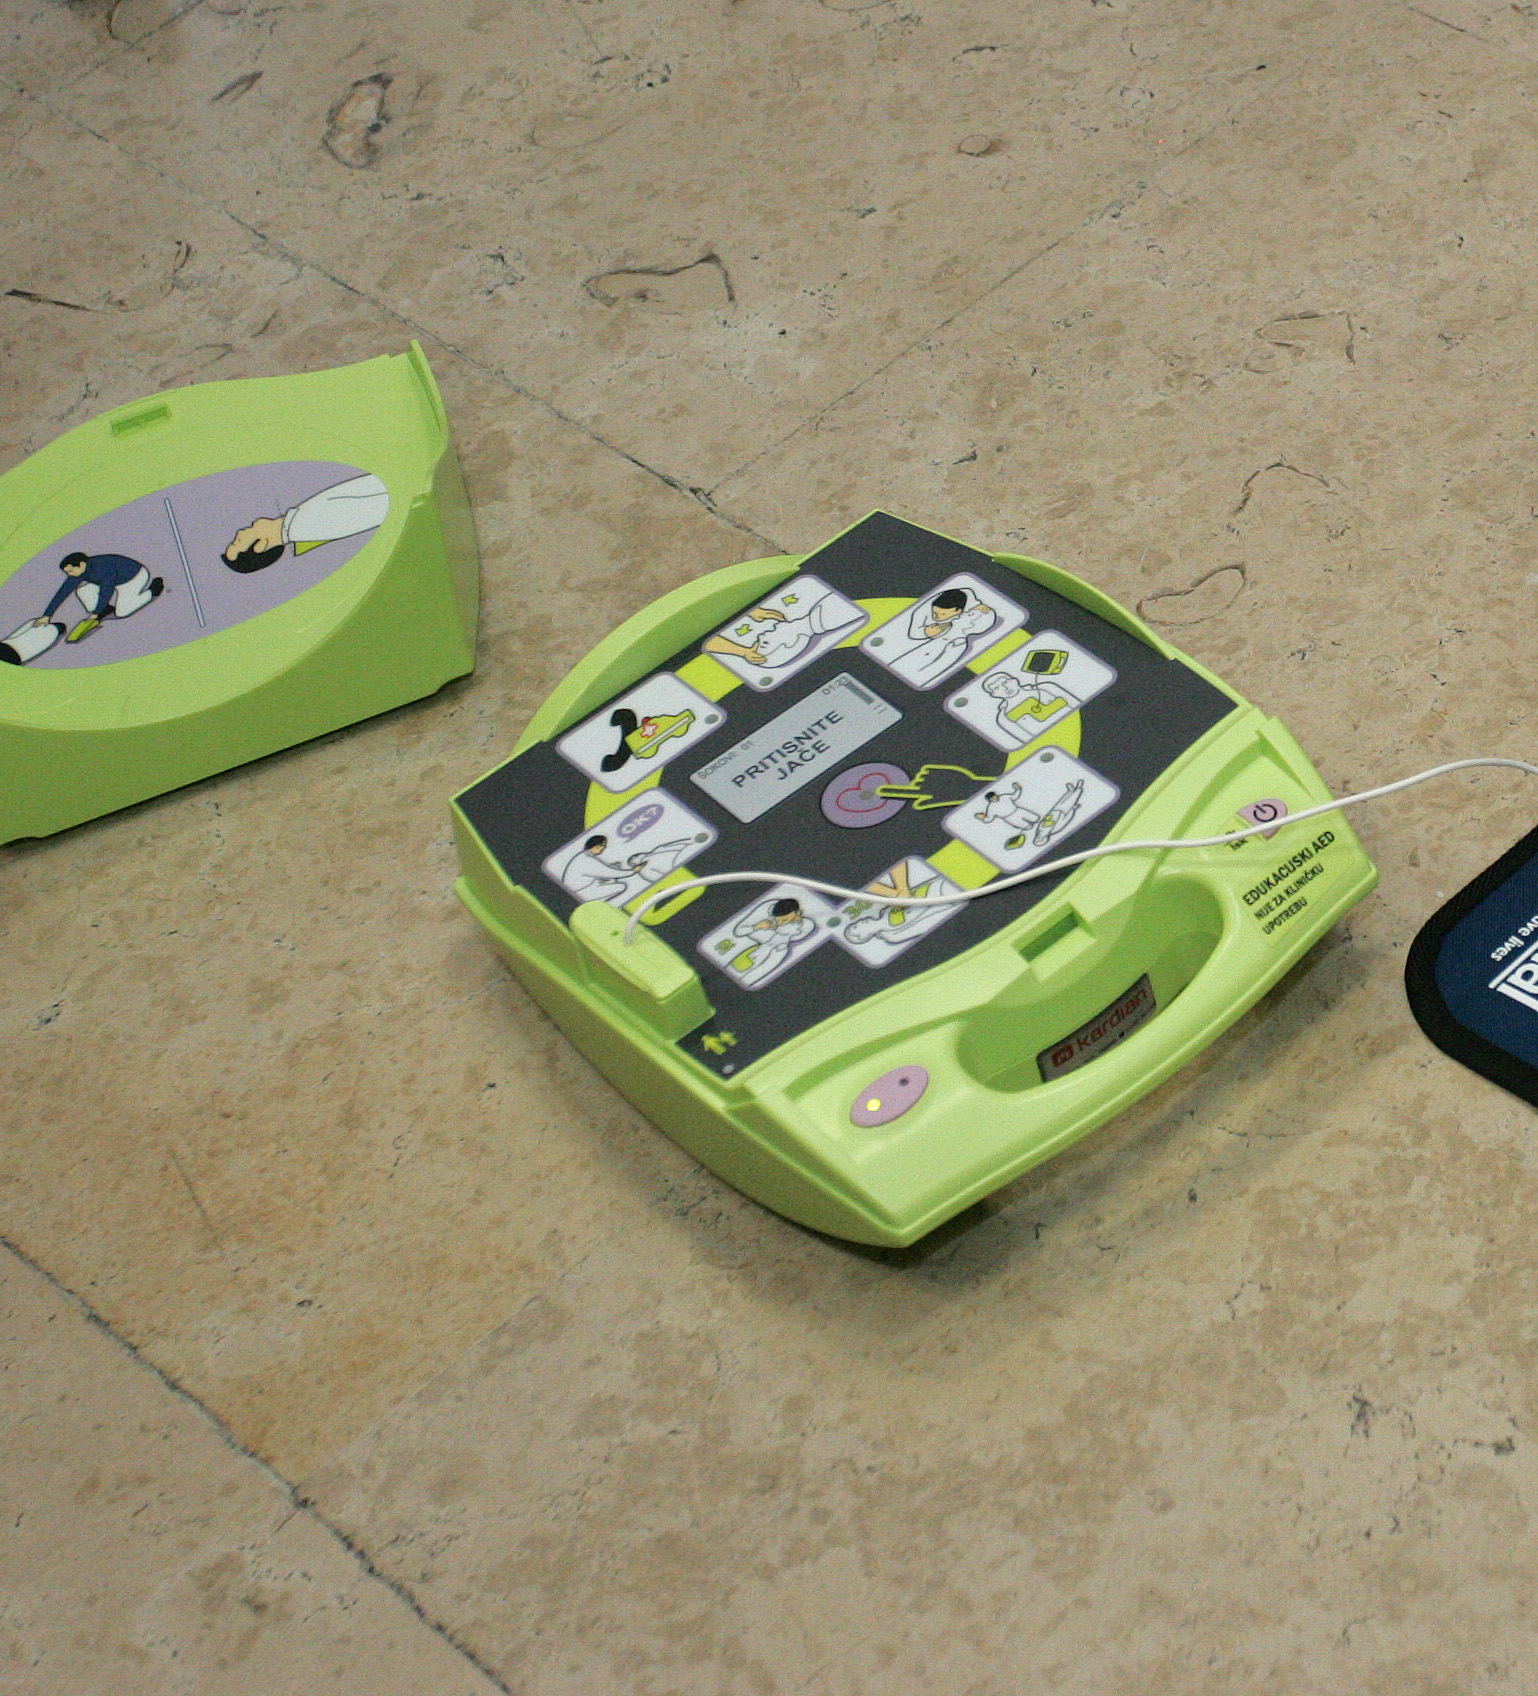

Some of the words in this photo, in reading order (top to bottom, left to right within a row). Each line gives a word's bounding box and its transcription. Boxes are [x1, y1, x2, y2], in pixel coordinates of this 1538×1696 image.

[731, 710, 844, 788] PRITISNITE
[777, 740, 831, 780] JAČE
[621, 806, 660, 834] OK?
[1312, 831, 1335, 853] AED
[1271, 894, 1286, 907] ZA
[1284, 863, 1324, 898] KLINIČKU
[1262, 896, 1308, 935] UPOTREBU
[1491, 935, 1525, 961] lives
